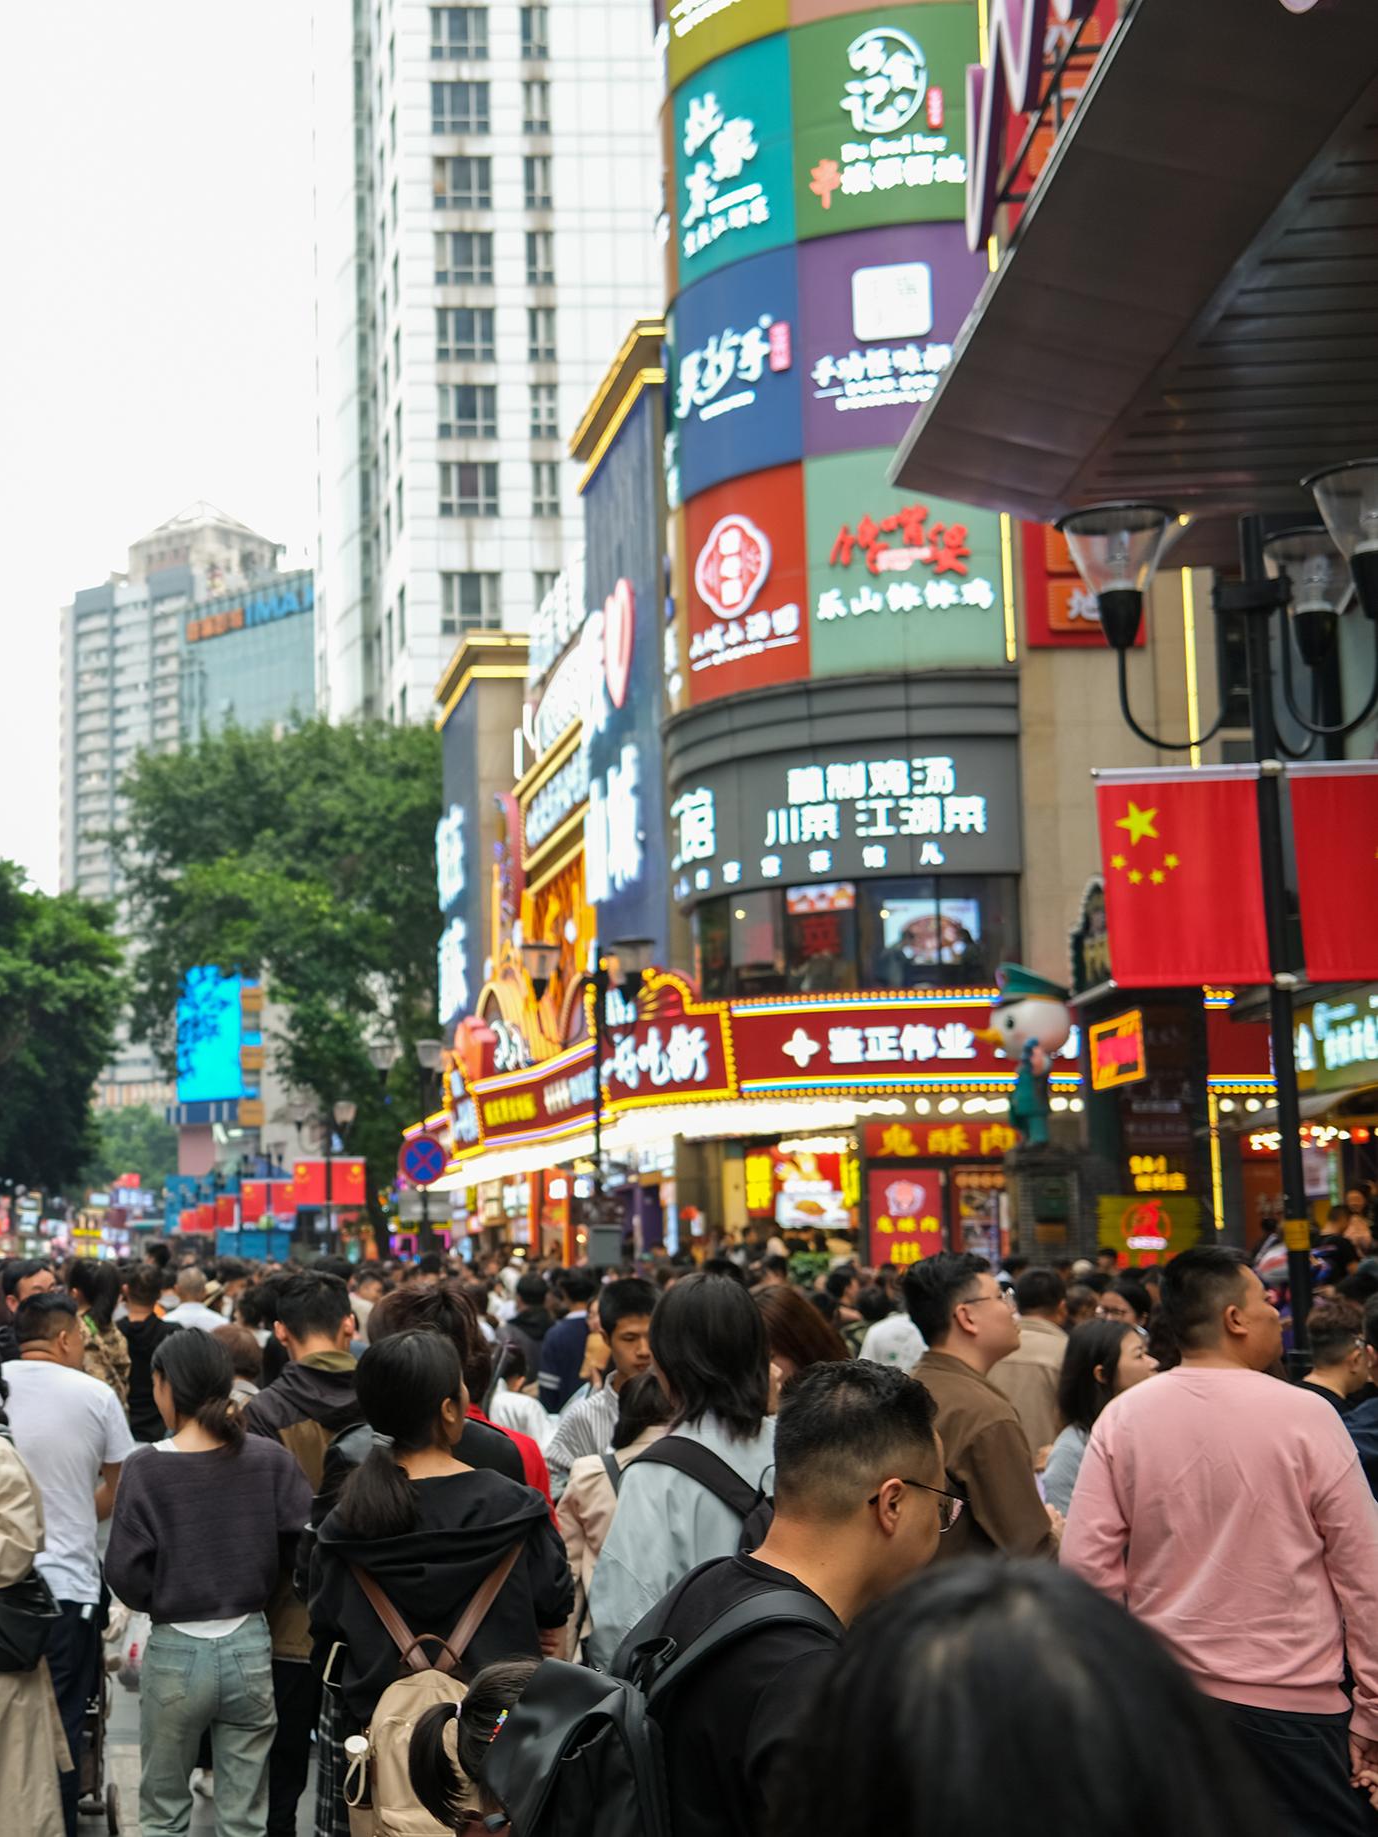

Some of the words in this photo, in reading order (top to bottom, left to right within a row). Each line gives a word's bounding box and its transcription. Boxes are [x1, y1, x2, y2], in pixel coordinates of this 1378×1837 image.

[764, 803, 839, 846] 川菜
[855, 795, 987, 836] 江湖菜
